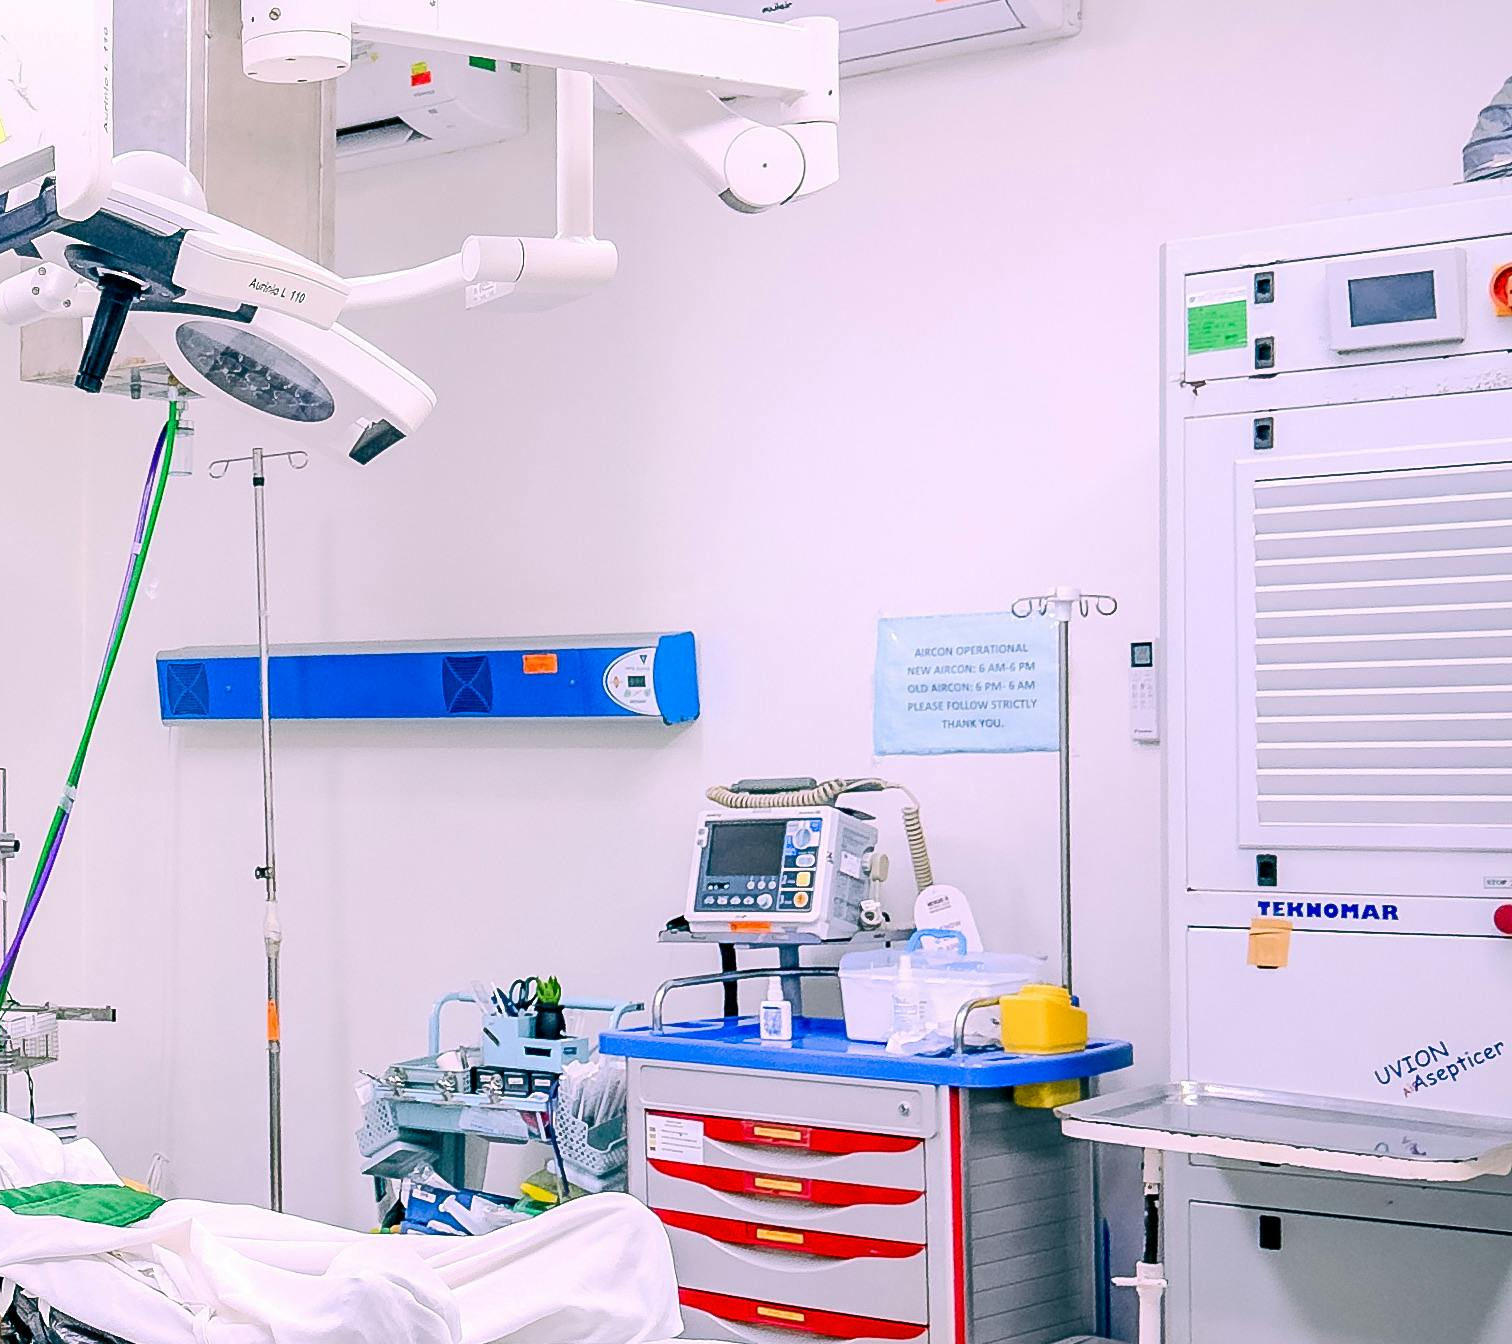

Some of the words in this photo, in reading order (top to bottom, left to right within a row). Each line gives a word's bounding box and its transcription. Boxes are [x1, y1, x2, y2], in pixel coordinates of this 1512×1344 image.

[281, 287, 286, 298] L
[290, 290, 306, 304] 110
[915, 647, 953, 658] AIRCON
[956, 643, 1029, 657] OPERATIONAL
[907, 666, 932, 676] NEW
[934, 664, 976, 675] AIRCON:
[978, 663, 986, 673] 6
[1019, 661, 1036, 671] PM
[907, 683, 929, 694] OLD
[931, 682, 974, 693] AIRCON:
[975, 681, 983, 692] 6
[1008, 680, 1015, 690] 6
[1017, 680, 1036, 690] AM
[907, 701, 944, 712] PLEASE
[946, 700, 989, 711] FOLLOW
[991, 698, 1038, 710] STRICTLY
[942, 719, 977, 729] THANK
[1257, 900, 1400, 921] TEKNOMAR
[1374, 1040, 1450, 1085] UVION
[1414, 1041, 1504, 1092] Asepticer
